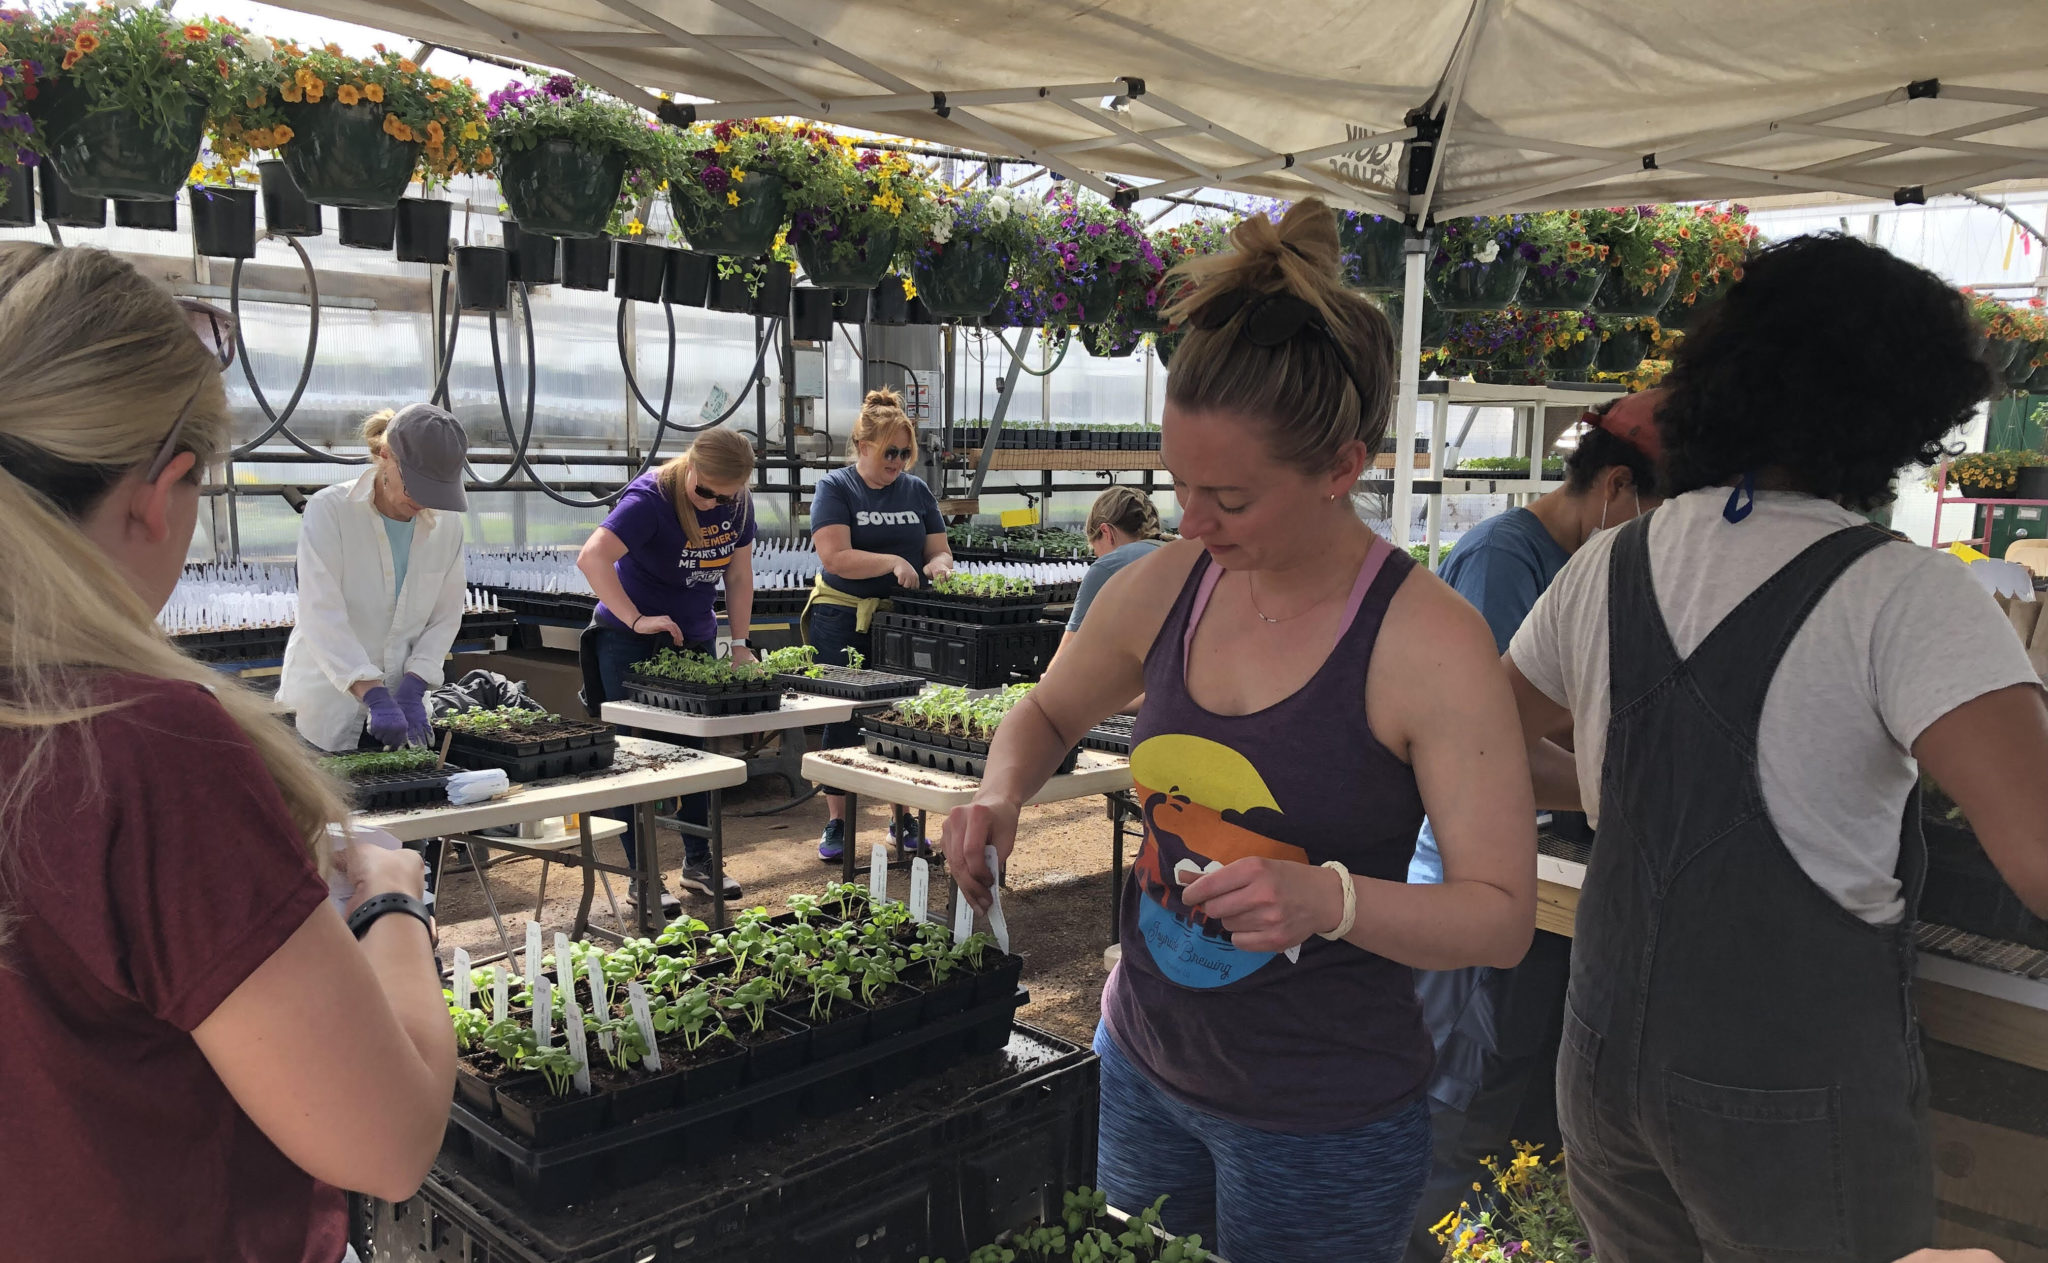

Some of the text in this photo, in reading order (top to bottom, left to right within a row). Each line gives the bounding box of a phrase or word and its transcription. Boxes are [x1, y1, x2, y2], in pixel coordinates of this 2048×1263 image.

[721, 520, 733, 531] O
[681, 542, 736, 559] STARTS WIT
[678, 559, 697, 569] ME
[1179, 941, 1232, 980] Brewing
